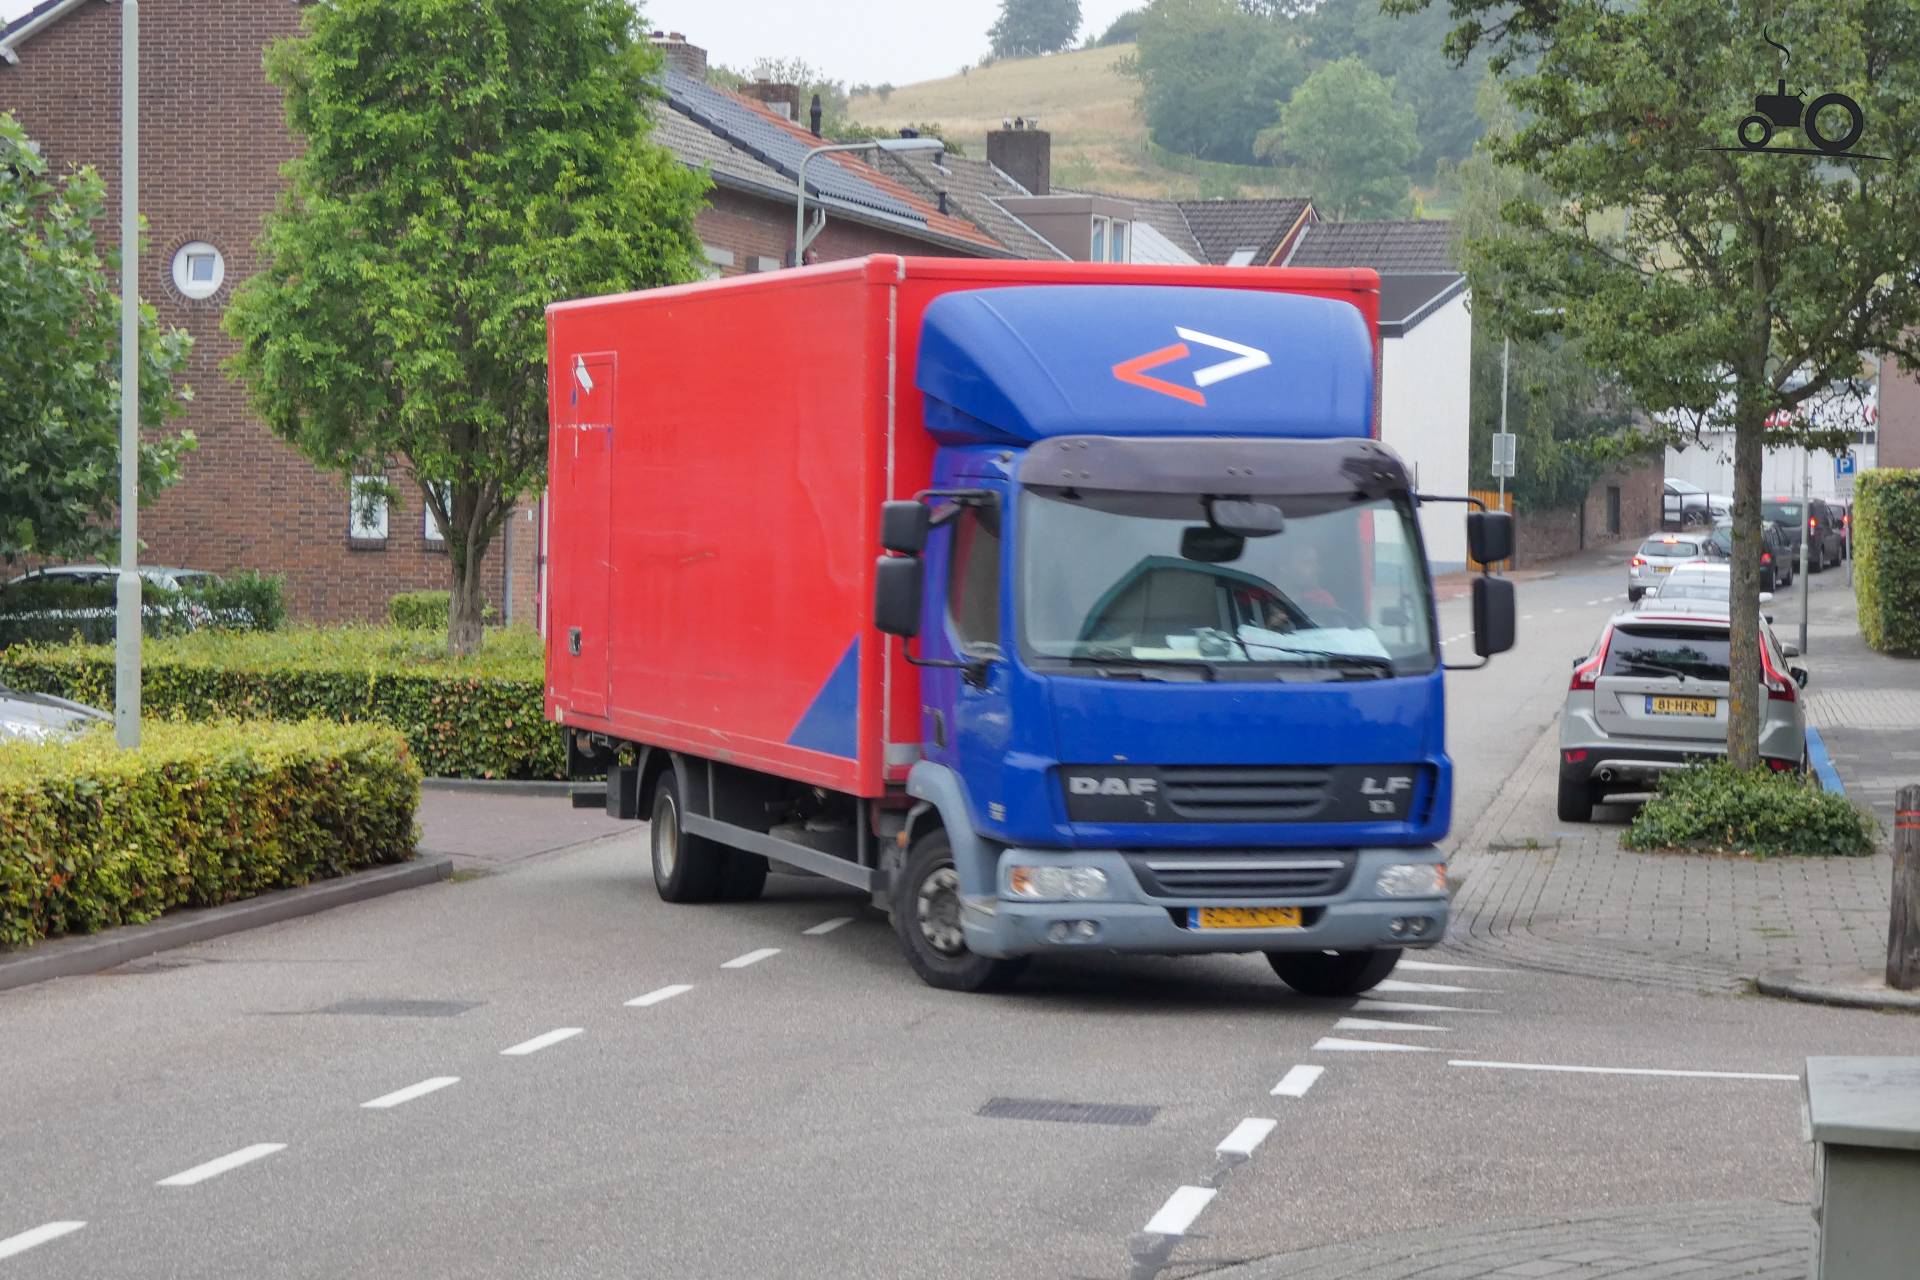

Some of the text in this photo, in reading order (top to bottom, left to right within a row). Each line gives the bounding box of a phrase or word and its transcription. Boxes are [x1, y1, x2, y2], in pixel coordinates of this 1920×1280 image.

[1839, 458, 1850, 473] P
[1069, 777, 1157, 795] DAF
[1360, 776, 1412, 794] LF
